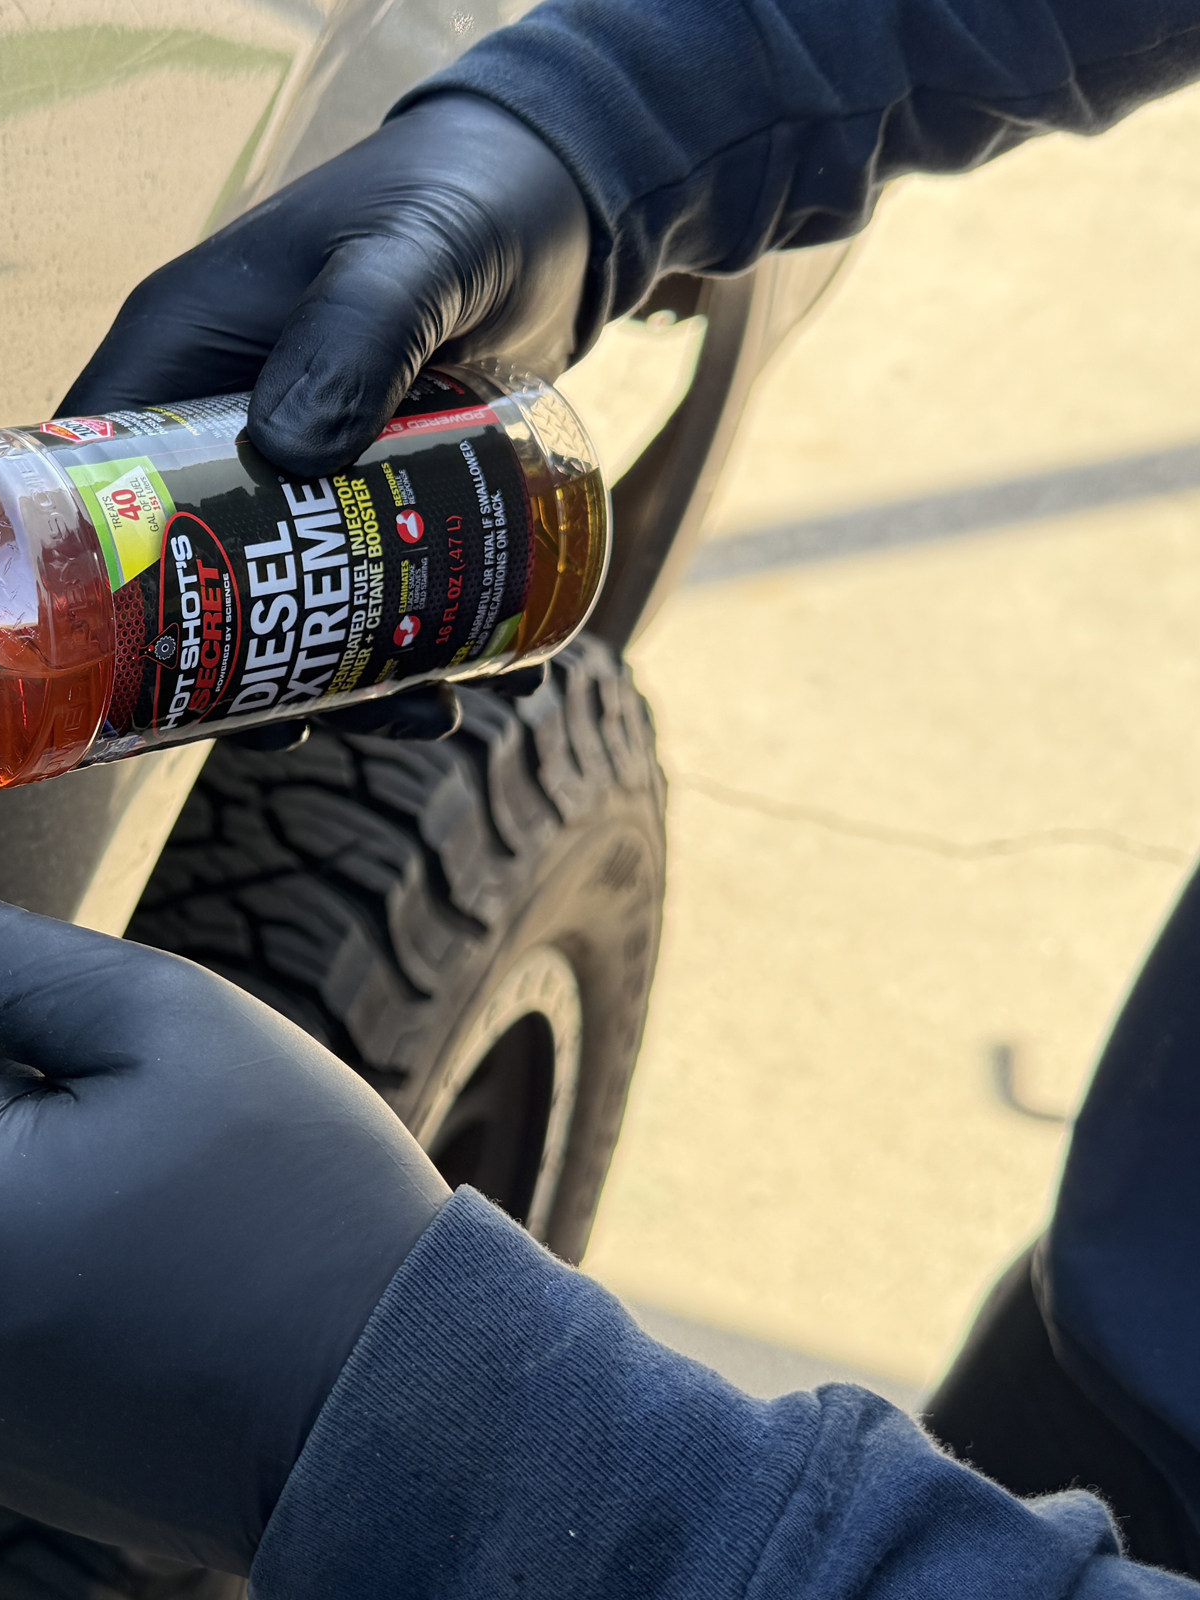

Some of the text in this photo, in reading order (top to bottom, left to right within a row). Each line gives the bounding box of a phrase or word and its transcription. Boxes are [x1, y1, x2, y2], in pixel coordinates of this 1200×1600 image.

[406, 410, 485, 430] POWERED
[140, 476, 161, 511] 151 Liters
[381, 462, 403, 507] RESTORES
[399, 468, 416, 505] RESPONSE
[459, 440, 492, 516] SWALLOWED.
[102, 495, 122, 530] TREATS
[111, 489, 142, 521] 40
[130, 477, 160, 532] GAL OF FUEL
[333, 474, 367, 557] INJECTOR
[351, 477, 384, 559] BOOSTER
[445, 514, 463, 532] L)
[482, 517, 493, 529] IF
[491, 488, 507, 527] BACK.
[484, 530, 496, 566] FATAL
[496, 529, 507, 551] ON
[353, 558, 369, 607] FUEL
[365, 561, 384, 629] CETANE
[399, 559, 409, 614] ELIMINATES
[447, 574, 463, 600] OZ
[482, 567, 494, 586] OR
[482, 551, 507, 630] PRECAUTIONS
[227, 520, 299, 715] DIESEL
[442, 602, 459, 622] FL
[467, 587, 491, 640] HARMFUL
[159, 534, 201, 730] HOT SHOT'S
[189, 558, 223, 710] SECRET
[215, 572, 232, 692] POWERED BY SCIENCE
[365, 633, 374, 644] +
[435, 625, 453, 644] 16
